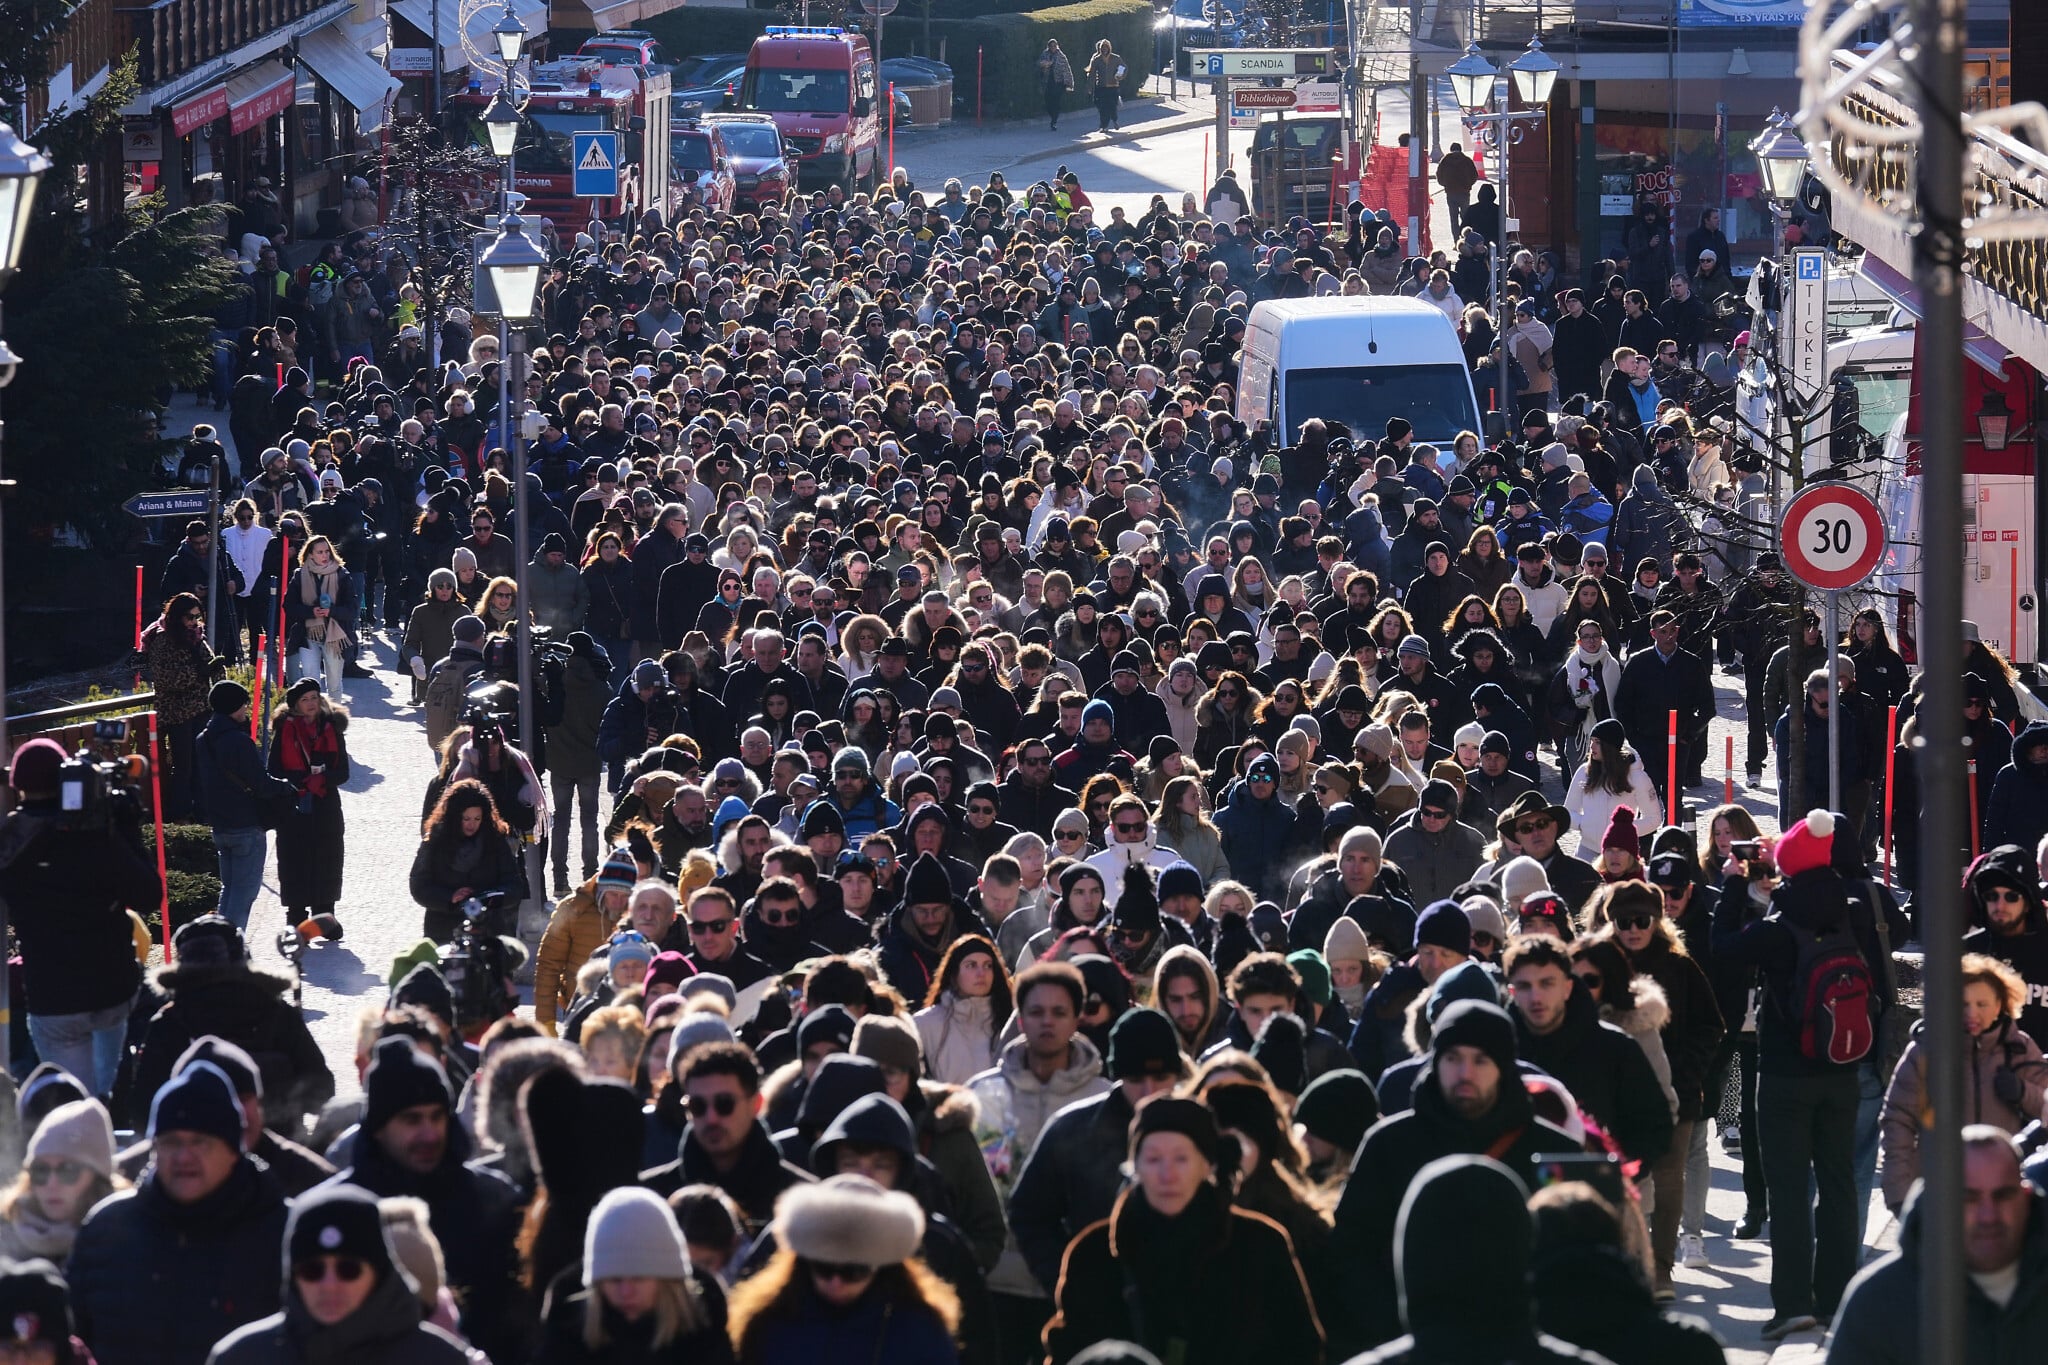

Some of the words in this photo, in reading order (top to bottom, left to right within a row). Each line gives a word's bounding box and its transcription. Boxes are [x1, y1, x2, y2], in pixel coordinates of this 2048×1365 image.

[1734, 12, 1752, 23] LES
[1755, 11, 1784, 22] VRAIS
[1240, 59, 1285, 69] SCANDIA
[1314, 56, 1325, 71] 4
[1239, 93, 1290, 105] Bibliothèque
[1804, 284, 1814, 389] TICKET
[138, 501, 165, 511] Ariana
[166, 501, 173, 509] &
[174, 499, 203, 508] Marina
[1812, 519, 1851, 554] 30
